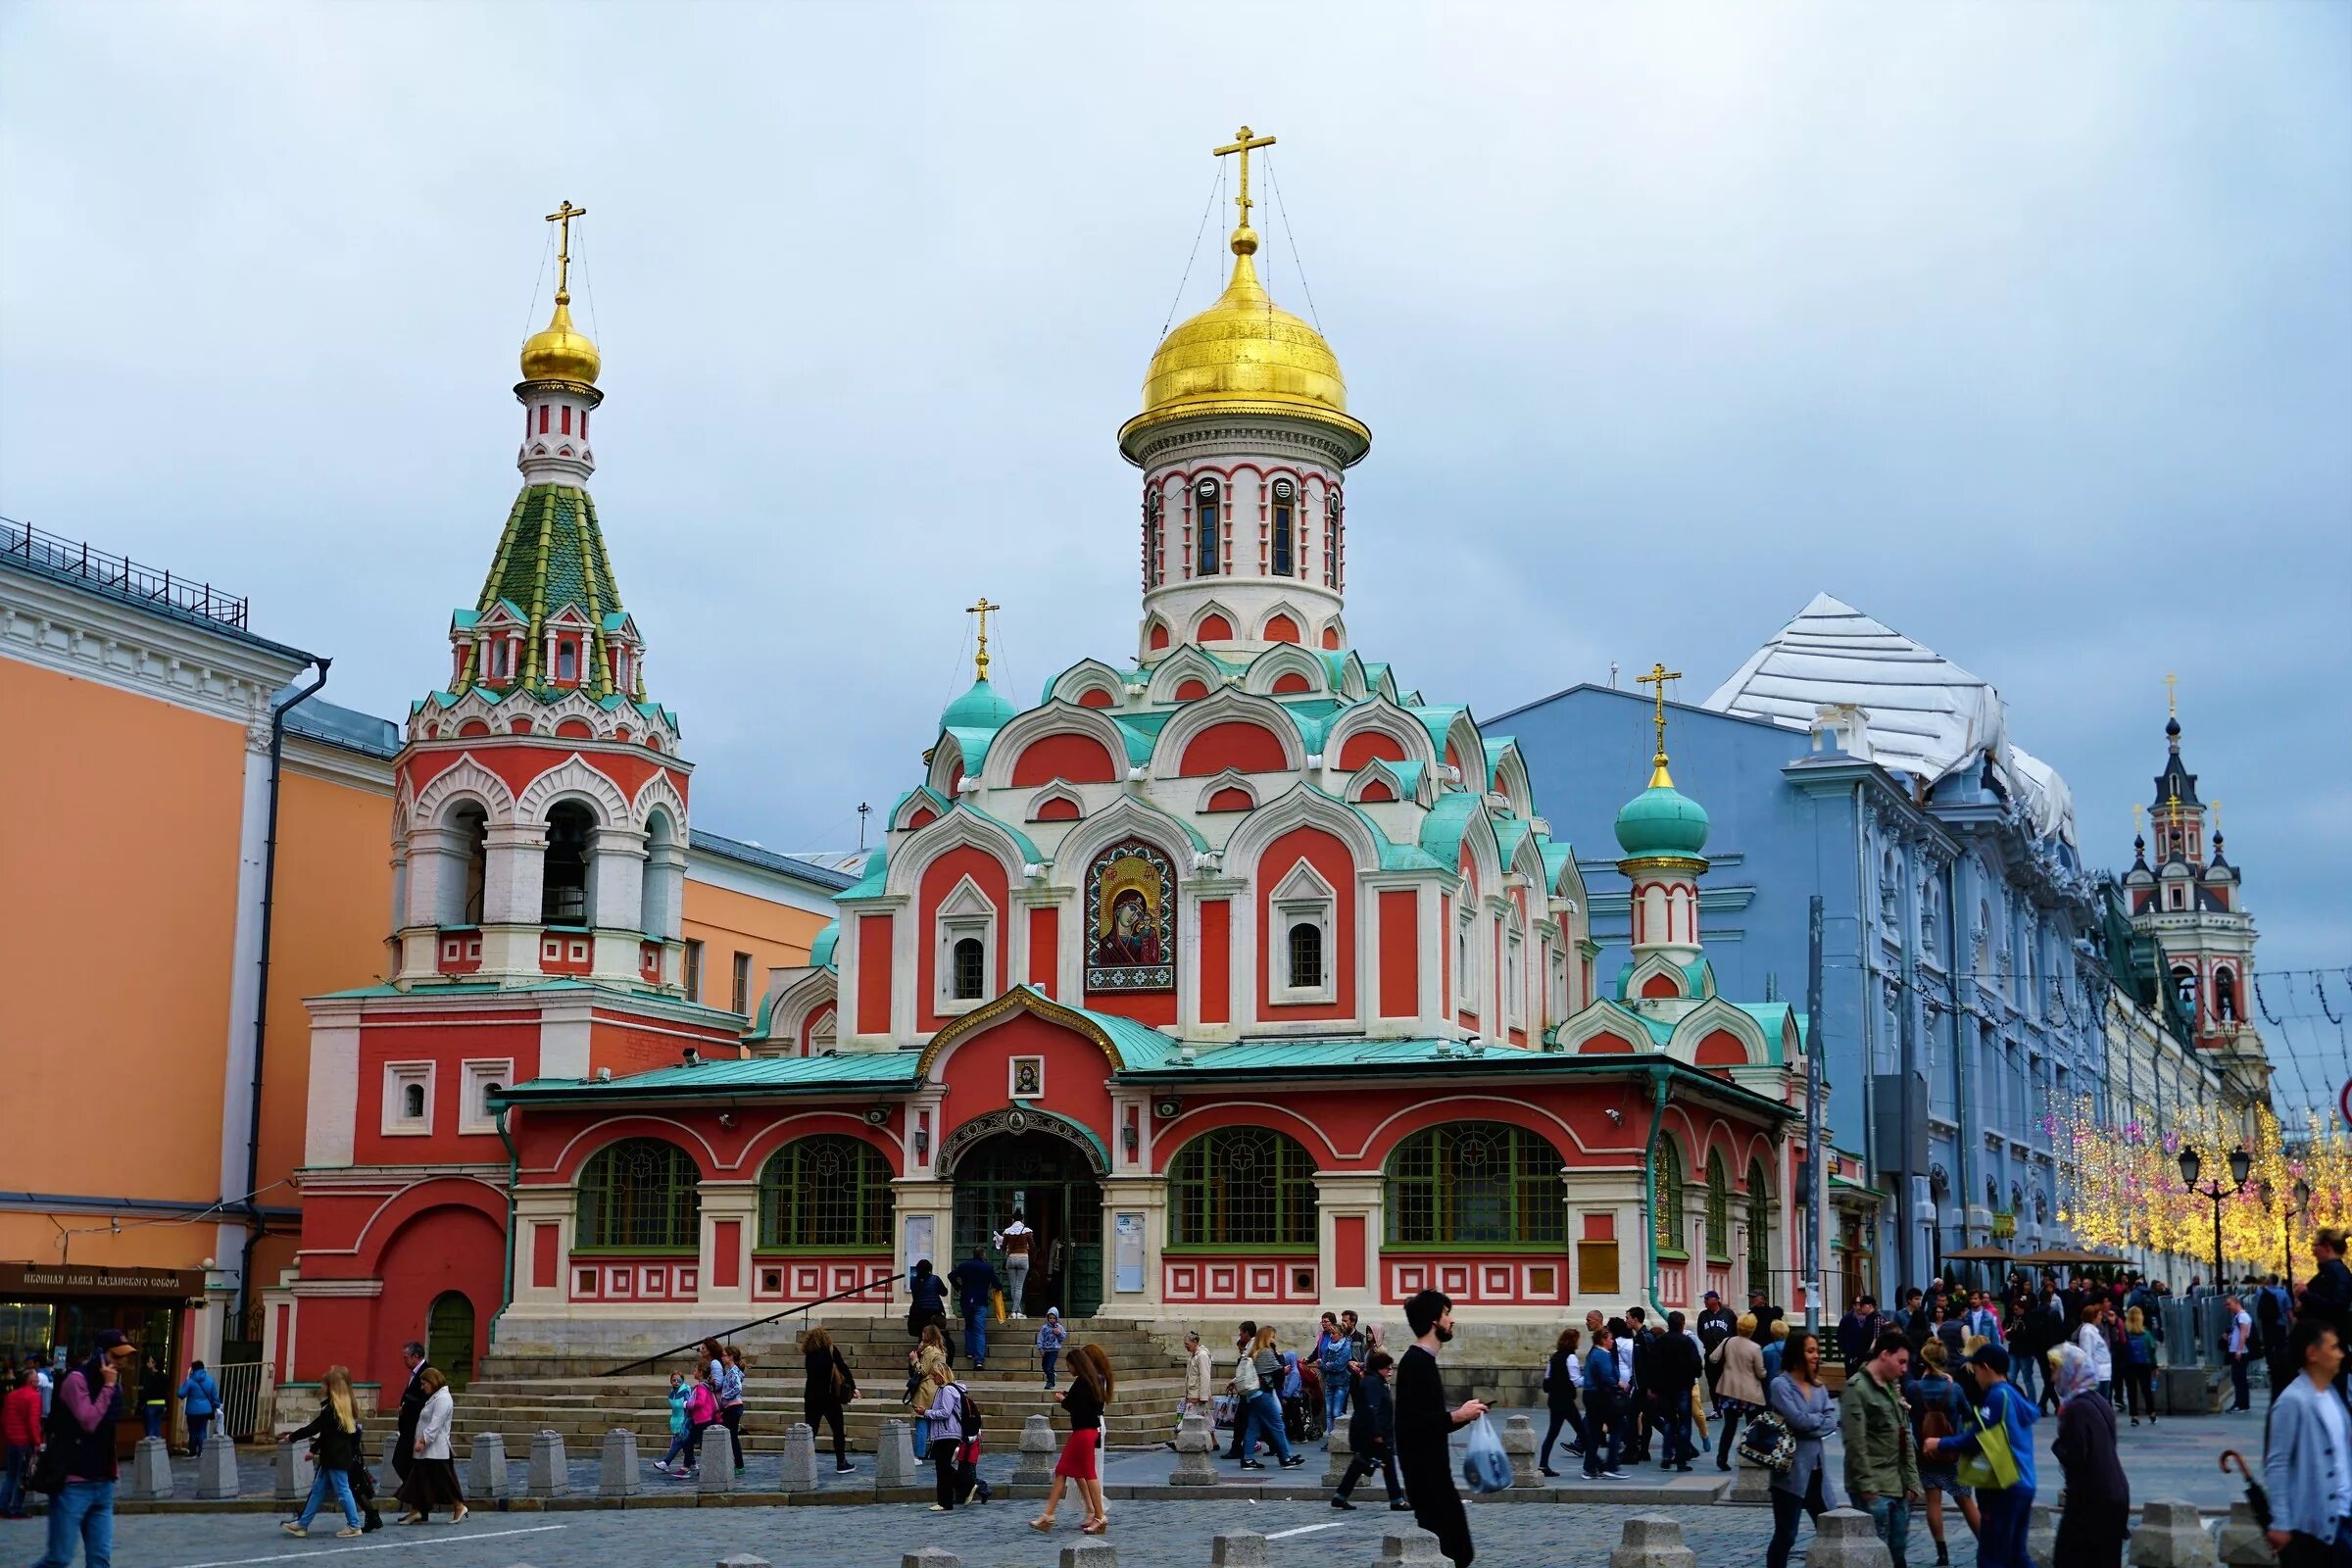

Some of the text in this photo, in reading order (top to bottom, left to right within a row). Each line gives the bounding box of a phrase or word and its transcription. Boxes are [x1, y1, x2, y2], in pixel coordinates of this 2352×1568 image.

[24, 1273, 180, 1288] ИКОННАЯ ЛАВКА КАЗАНСКОГО СОБОРА
